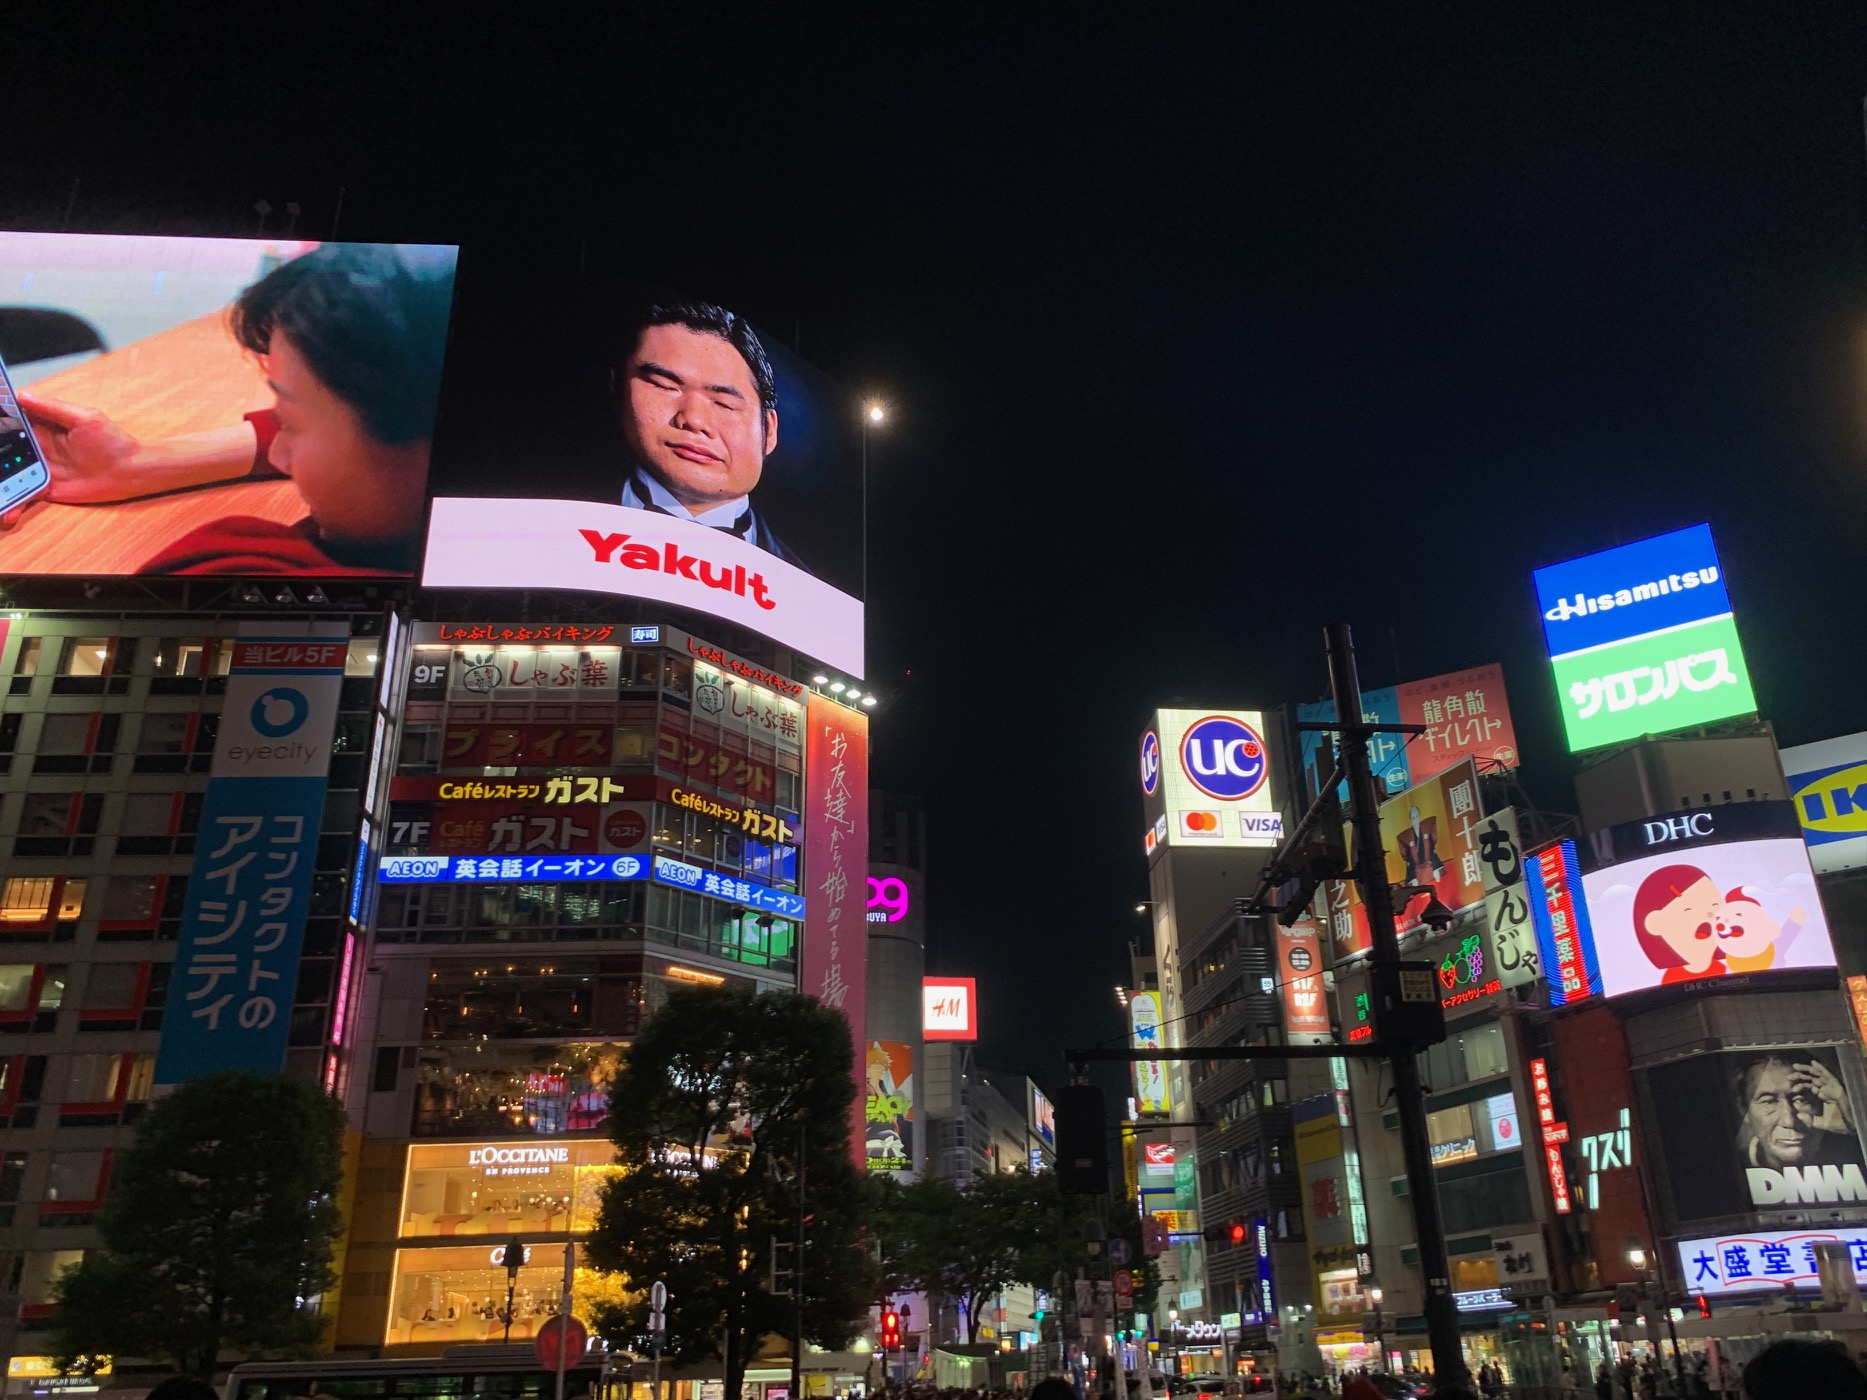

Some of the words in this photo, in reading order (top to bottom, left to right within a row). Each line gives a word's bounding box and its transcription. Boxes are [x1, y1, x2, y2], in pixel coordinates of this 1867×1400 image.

[578, 529, 777, 610] Yakult
[1545, 566, 1719, 621] Hisamitsu
[440, 624, 615, 642] しゃぶしゃぶバイキング
[633, 628, 658, 640] 寿司
[243, 646, 336, 665] 当ビル5F
[687, 637, 804, 698] しゃぶしゃぶバイキング
[414, 666, 446, 683] 9F
[510, 659, 609, 687] しゃぶ葉
[1569, 648, 1738, 719] サロンパス
[731, 690, 798, 739] しゃぶ葉
[1422, 689, 1487, 724] 龍角散
[228, 741, 318, 763] eyecity
[446, 729, 609, 757] プライス
[658, 734, 773, 792] コンタクト
[1190, 739, 1260, 777] UC
[545, 776, 625, 803] ガスト
[393, 821, 431, 843] 7F
[440, 820, 484, 838] Café
[488, 815, 591, 851] ガスト
[742, 809, 794, 843] ガスト
[1242, 818, 1282, 832] VISA
[1643, 812, 1715, 845] DHC
[388, 860, 440, 878] AEON
[455, 858, 606, 879] 英会話イーオン
[615, 861, 637, 875] 6F
[660, 863, 698, 886] AEON
[704, 873, 803, 914] 英会話イーオン
[1479, 819, 1539, 976] もんじゃ
[187, 816, 263, 1030] アイシティ
[239, 815, 304, 1029] コンタクトの
[1684, 982, 1707, 992] DHC
[932, 998, 961, 1018] H&M
[469, 1147, 568, 1164] L'OCCITANE
[1582, 1107, 1633, 1210] クスリ
[502, 1167, 550, 1175] PROVENCE
